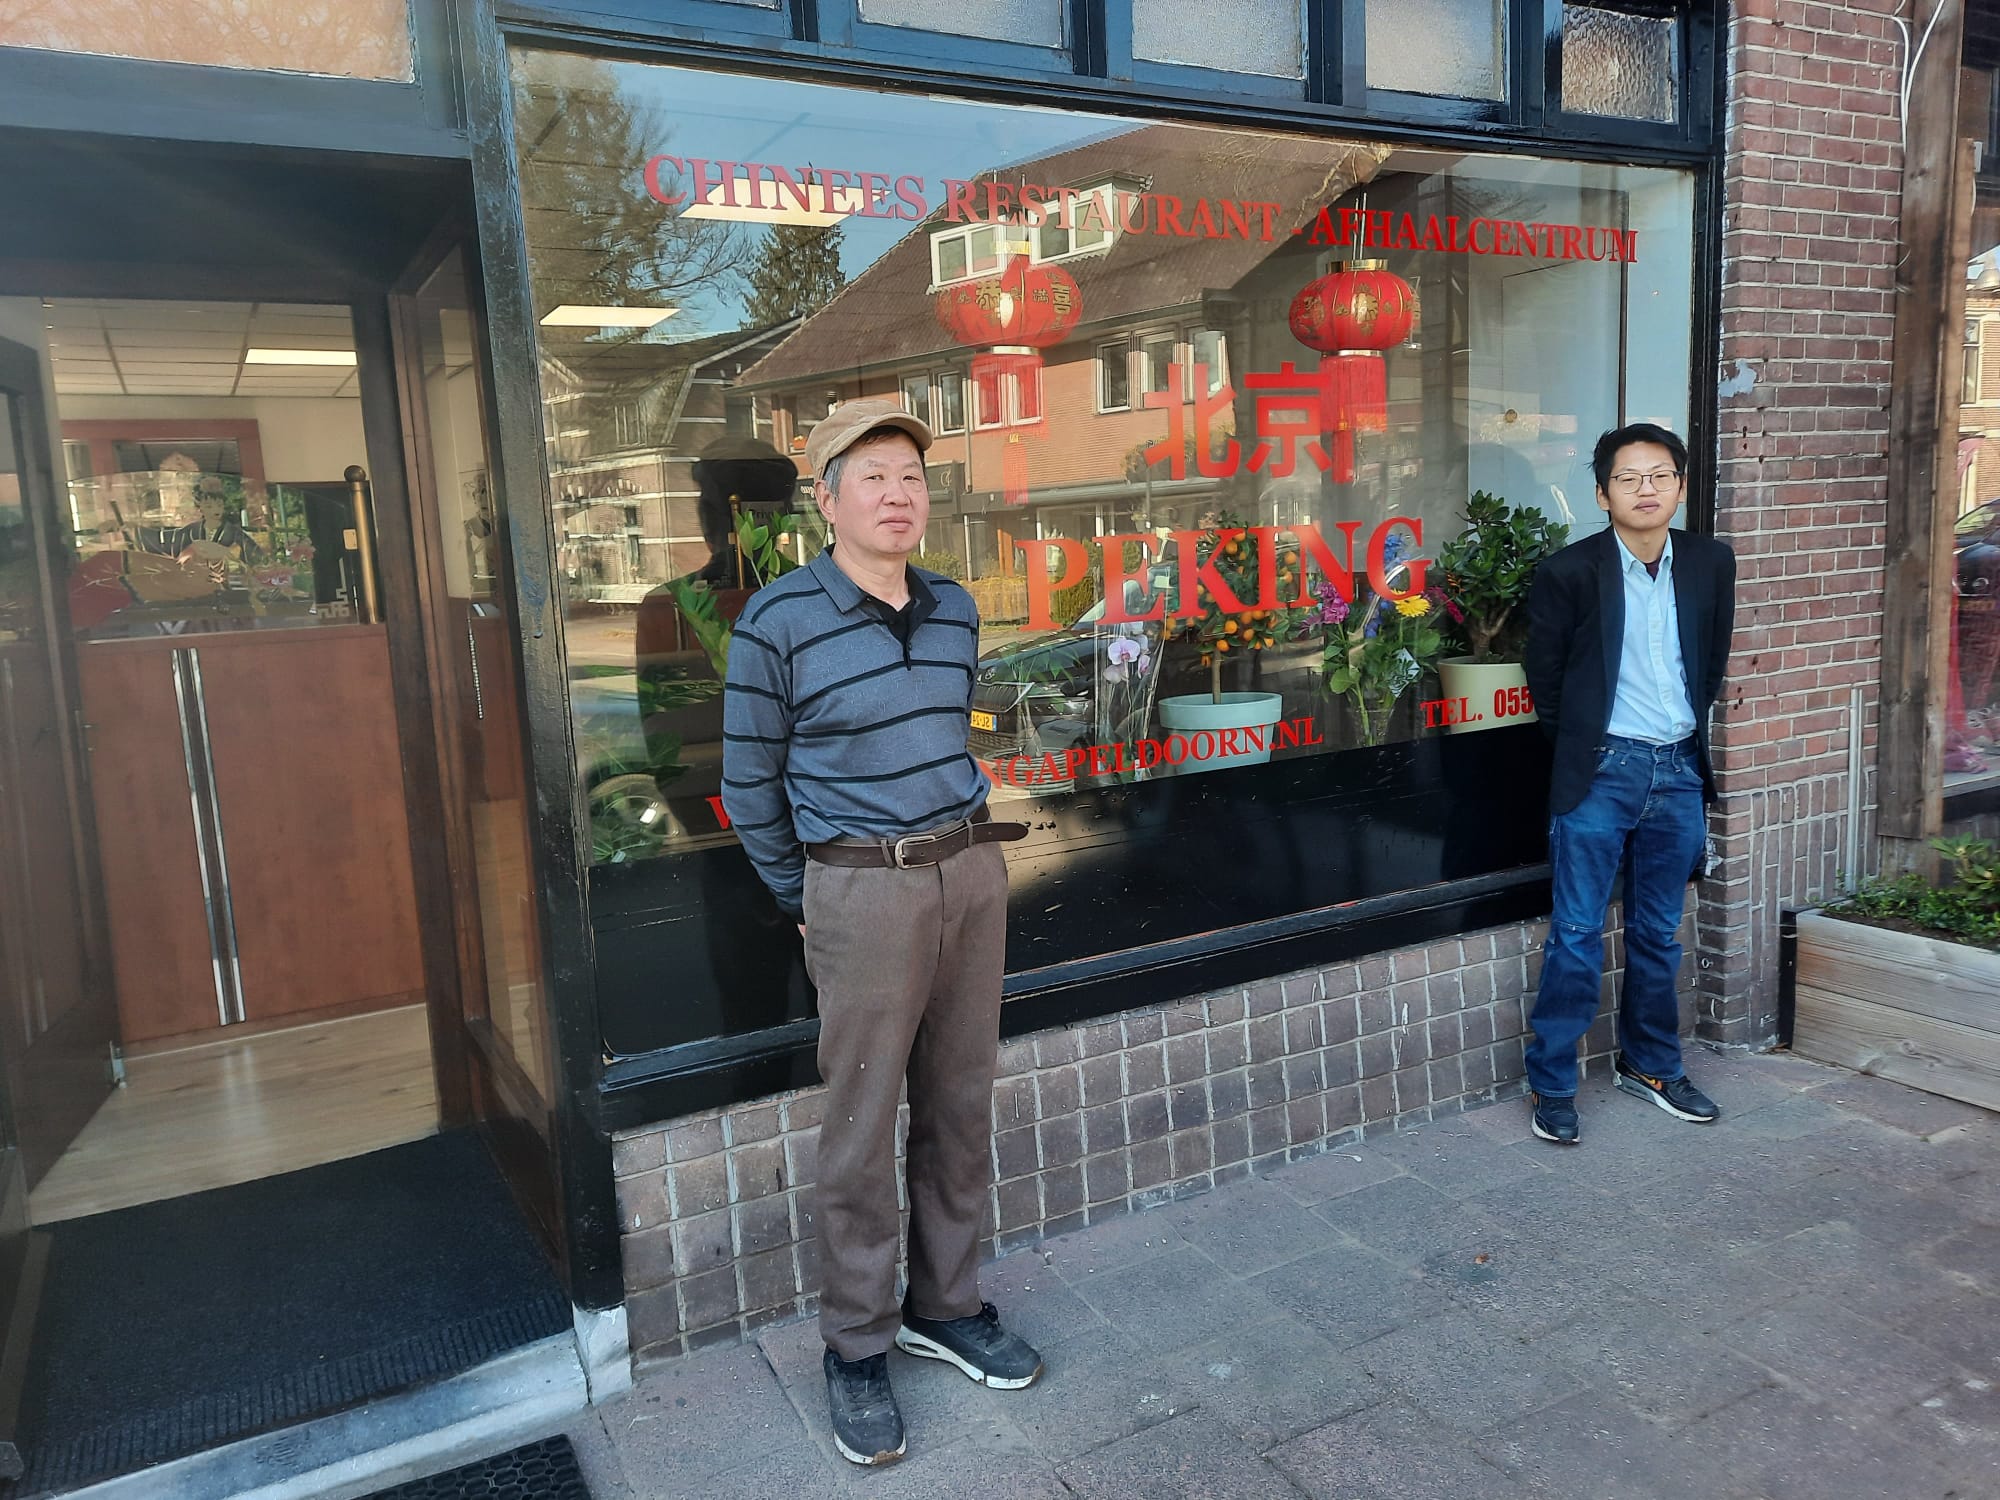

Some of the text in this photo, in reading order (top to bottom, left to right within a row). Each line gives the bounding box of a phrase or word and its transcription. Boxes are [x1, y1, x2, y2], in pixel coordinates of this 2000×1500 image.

[643, 154, 927, 221] CHINEES
[941, 179, 1281, 242] RESTAURANT
[1307, 206, 1638, 263] AFHAALCENTRUM
[1143, 361, 1331, 480] 北京
[1015, 516, 1431, 632] PEKING
[978, 716, 1324, 788] NGAPELDOORN.NL
[1420, 685, 1535, 729] TEL. 055
